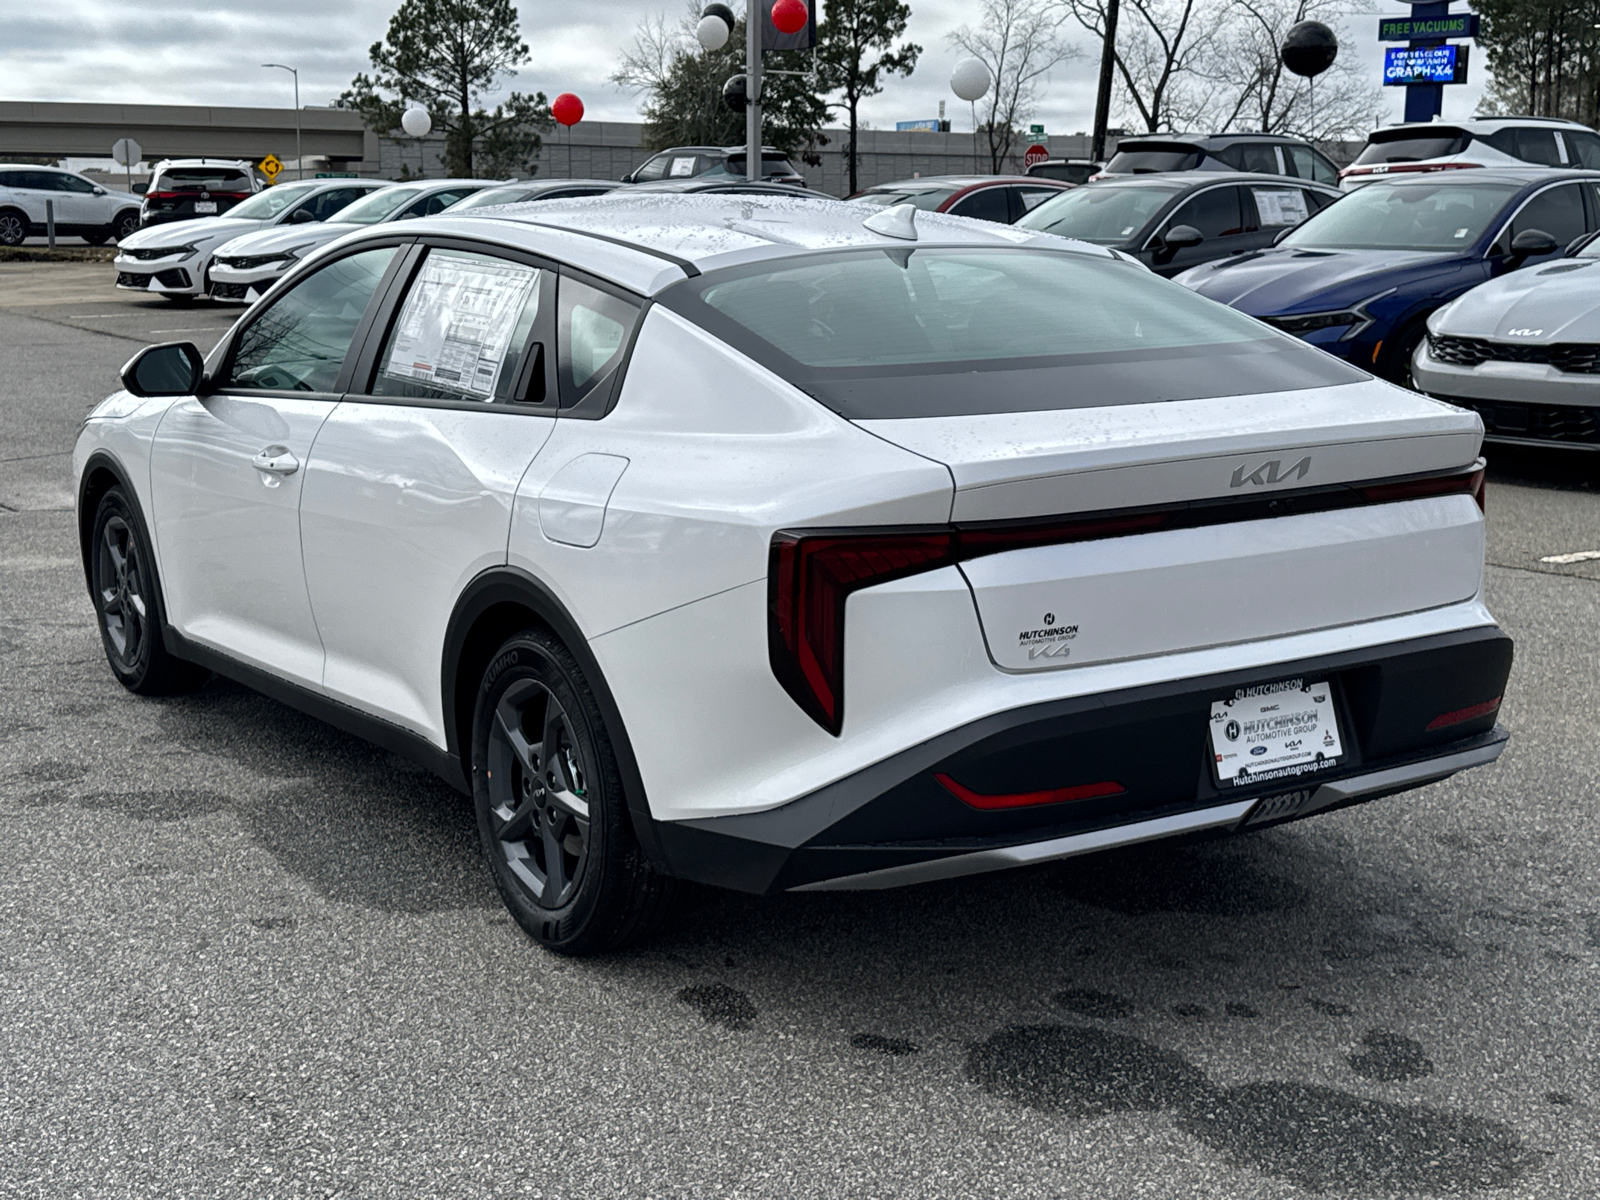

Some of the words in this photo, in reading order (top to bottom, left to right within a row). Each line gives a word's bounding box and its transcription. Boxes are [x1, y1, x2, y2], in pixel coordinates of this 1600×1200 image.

[1383, 23, 1410, 35] FREE
[1413, 19, 1464, 33] VACUUMS
[1387, 64, 1453, 78] GRAPH-X4
[1027, 154, 1048, 165] STOP
[1230, 456, 1311, 488] KIA
[1019, 625, 1079, 640] HUTCHINSON
[1020, 638, 1056, 646] AUTOMOTIVE
[1057, 634, 1076, 642] GROUP
[1029, 642, 1070, 660] K4
[484, 651, 518, 692] KUMHO
[1245, 678, 1303, 698] HUTCHINSON
[1260, 704, 1279, 713] GMC
[1244, 709, 1318, 735] HUTCHINSON
[1246, 730, 1292, 744] AUTOMOTIVE
[1294, 724, 1317, 736] GROUP
[1233, 758, 1336, 786] Hutchinsonautogroup.com
